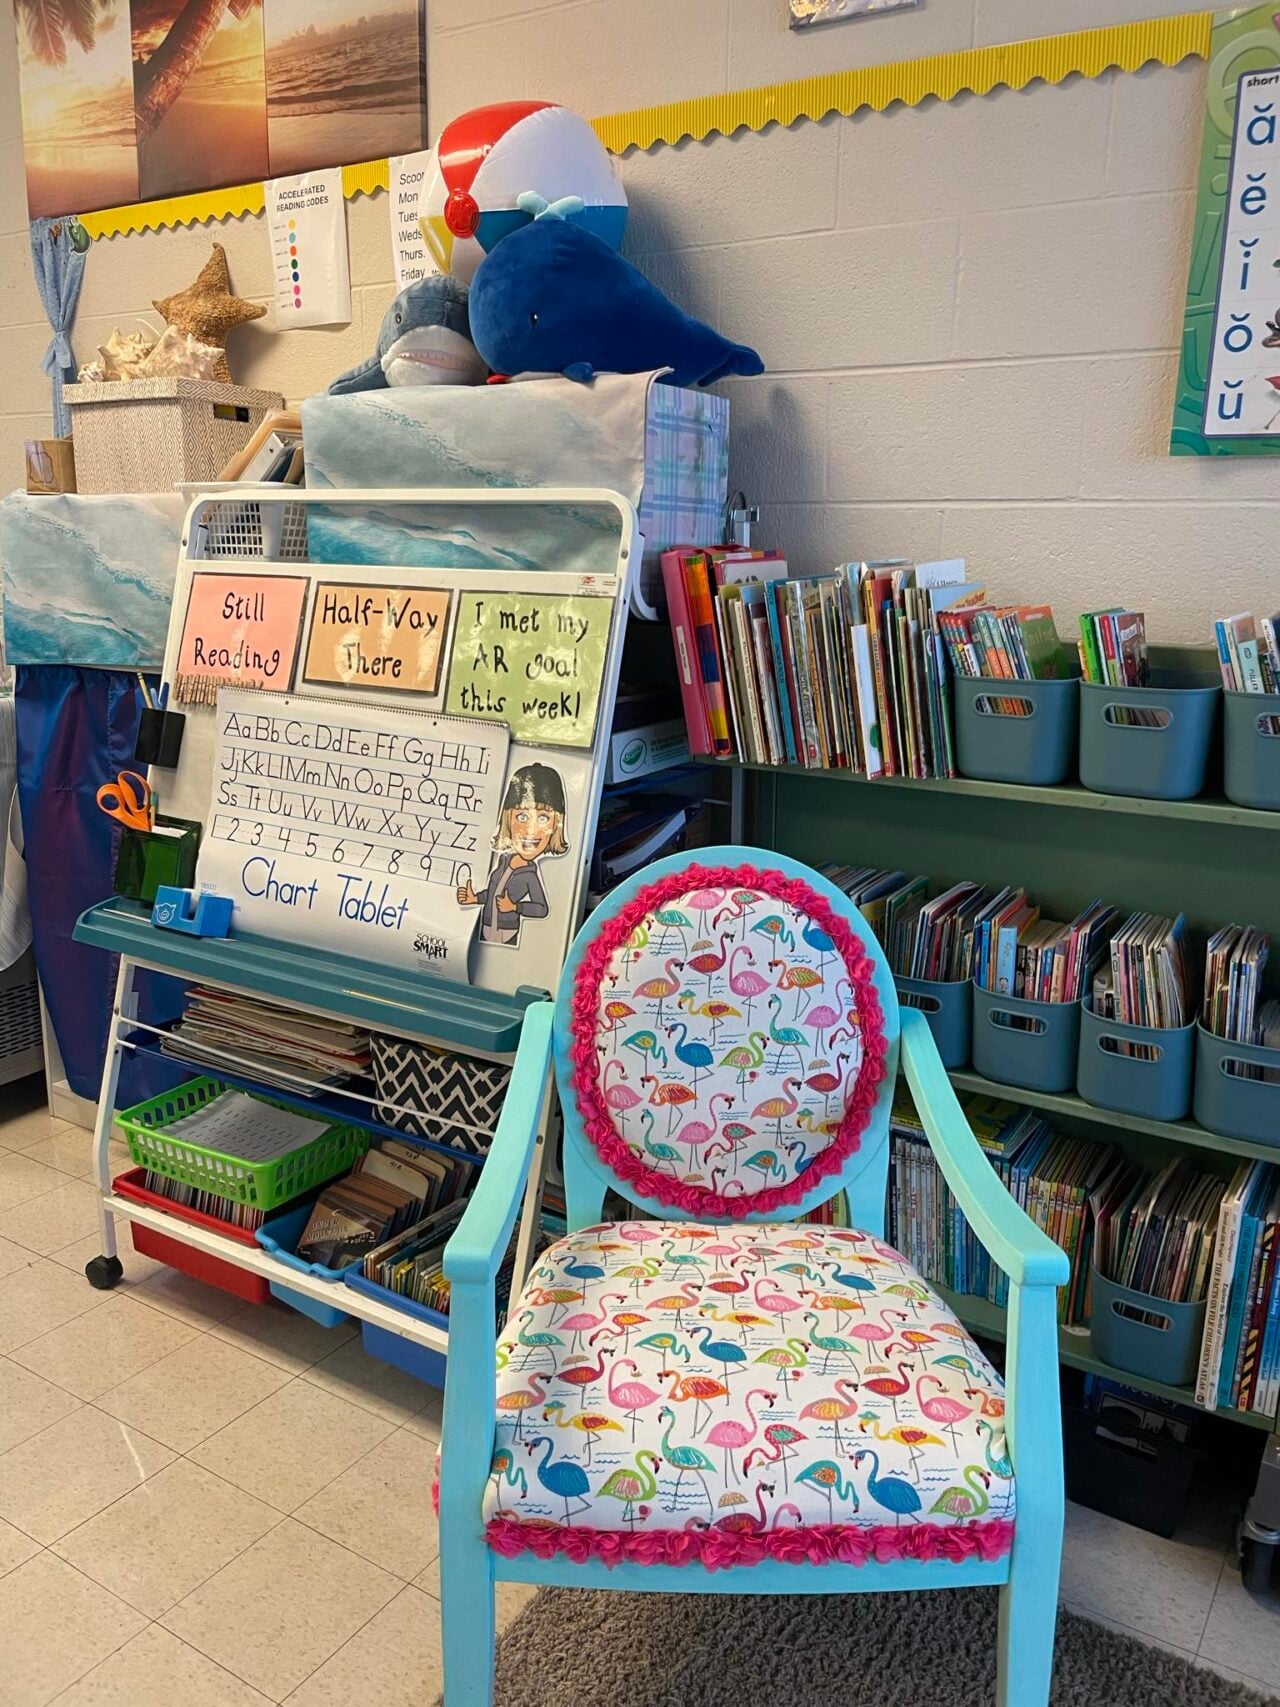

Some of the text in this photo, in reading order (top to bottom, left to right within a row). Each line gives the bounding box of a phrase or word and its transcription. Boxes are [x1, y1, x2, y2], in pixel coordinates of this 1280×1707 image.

[279, 184, 326, 201] ACCELERATED
[276, 195, 329, 213] READING CODES
[399, 249, 426, 262] Thurs.
[400, 268, 425, 282] Friday
[221, 591, 265, 623] Still
[321, 592, 438, 639] Half-Way
[474, 601, 590, 644] I met my
[193, 637, 280, 677] Reading
[341, 641, 402, 678] There
[472, 642, 578, 680] AR goal
[460, 682, 507, 713] this
[226, 817, 240, 842] 2
[250, 822, 264, 846] 3
[278, 826, 292, 853] 4
[304, 832, 320, 858] 5
[331, 839, 346, 864] 6
[359, 842, 374, 868] 7
[387, 848, 405, 875] 8
[419, 854, 433, 882] 9
[241, 856, 410, 931] Chart Tablet
[412, 940, 449, 961] SMART
[416, 933, 446, 947] SCHOOL
[1214, 1262, 1223, 1277] THE
[1211, 1277, 1220, 1299] FACTS
[1207, 1310, 1216, 1326] FILE
[1198, 1368, 1208, 1390] ATLAS
